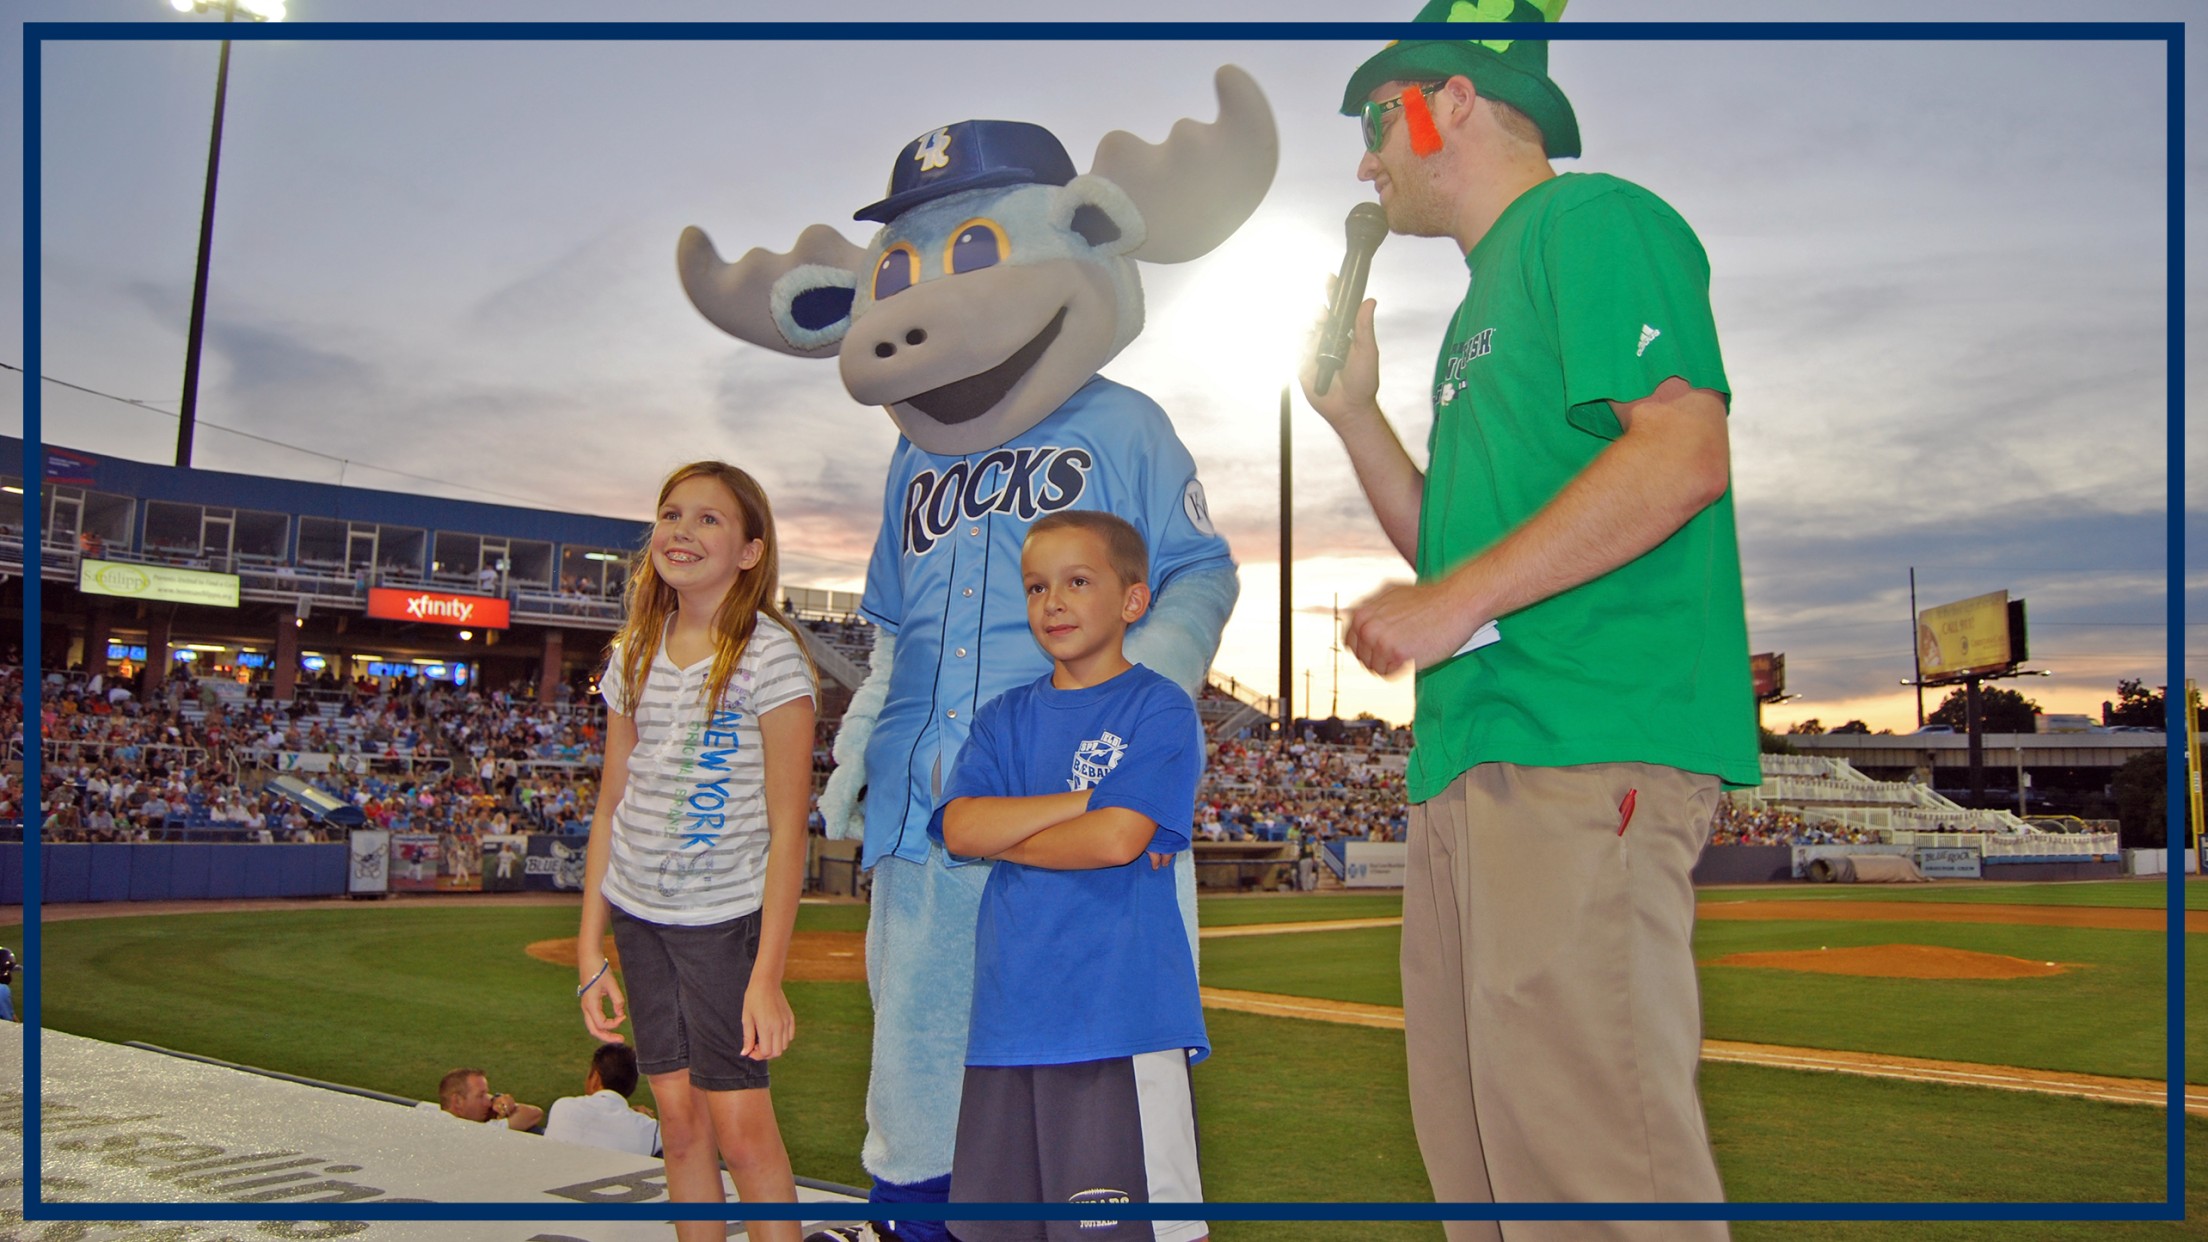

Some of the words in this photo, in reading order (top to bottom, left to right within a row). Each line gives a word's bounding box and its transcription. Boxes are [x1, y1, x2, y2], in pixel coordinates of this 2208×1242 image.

[903, 447, 1092, 559] ROCKS
[406, 594, 474, 622] xfinity
[697, 710, 743, 772] NEW
[679, 777, 732, 850] YORK
[527, 857, 561, 873] BLUE
